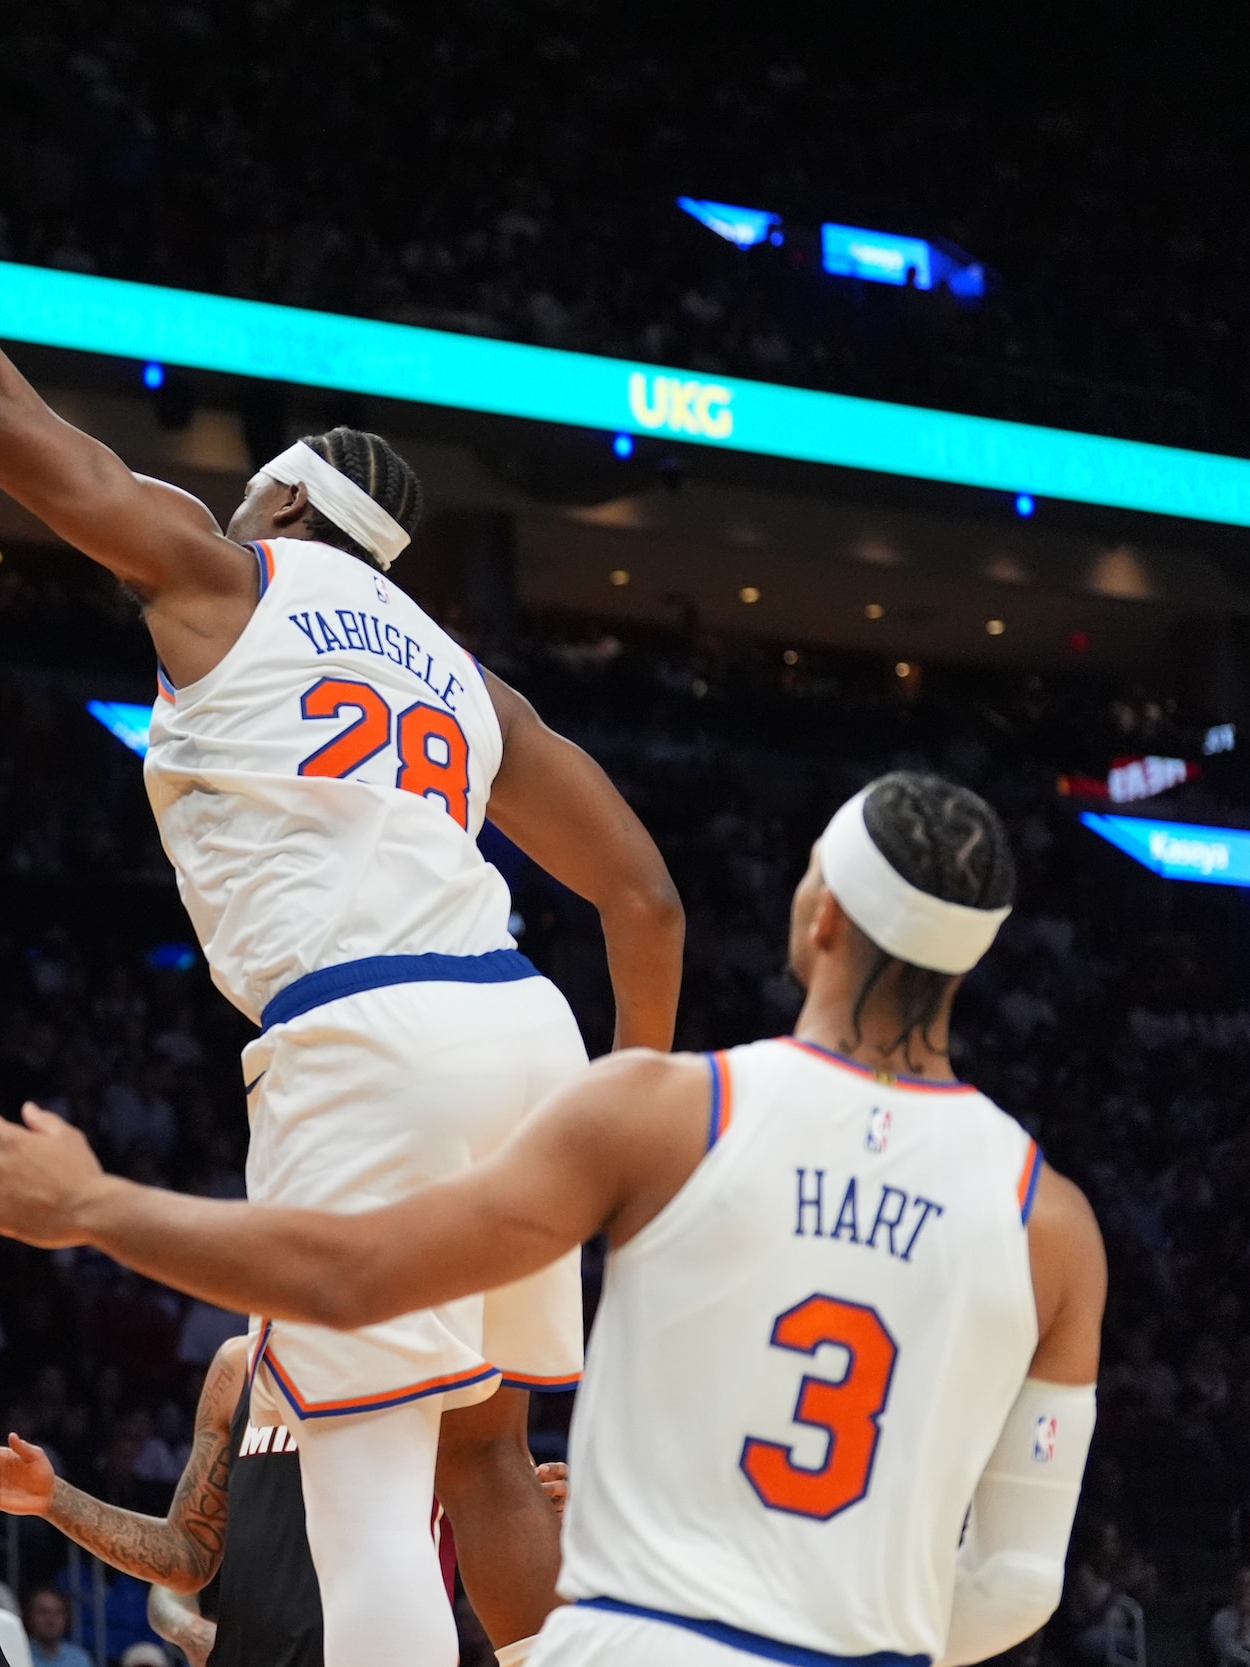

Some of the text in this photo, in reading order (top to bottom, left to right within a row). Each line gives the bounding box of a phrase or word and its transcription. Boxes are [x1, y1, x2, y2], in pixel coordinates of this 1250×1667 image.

[628, 371, 733, 438] UKG
[288, 610, 464, 712] YABUSELE
[297, 676, 470, 833] 28
[794, 1168, 944, 1262] HART
[739, 1292, 900, 1523] 3
